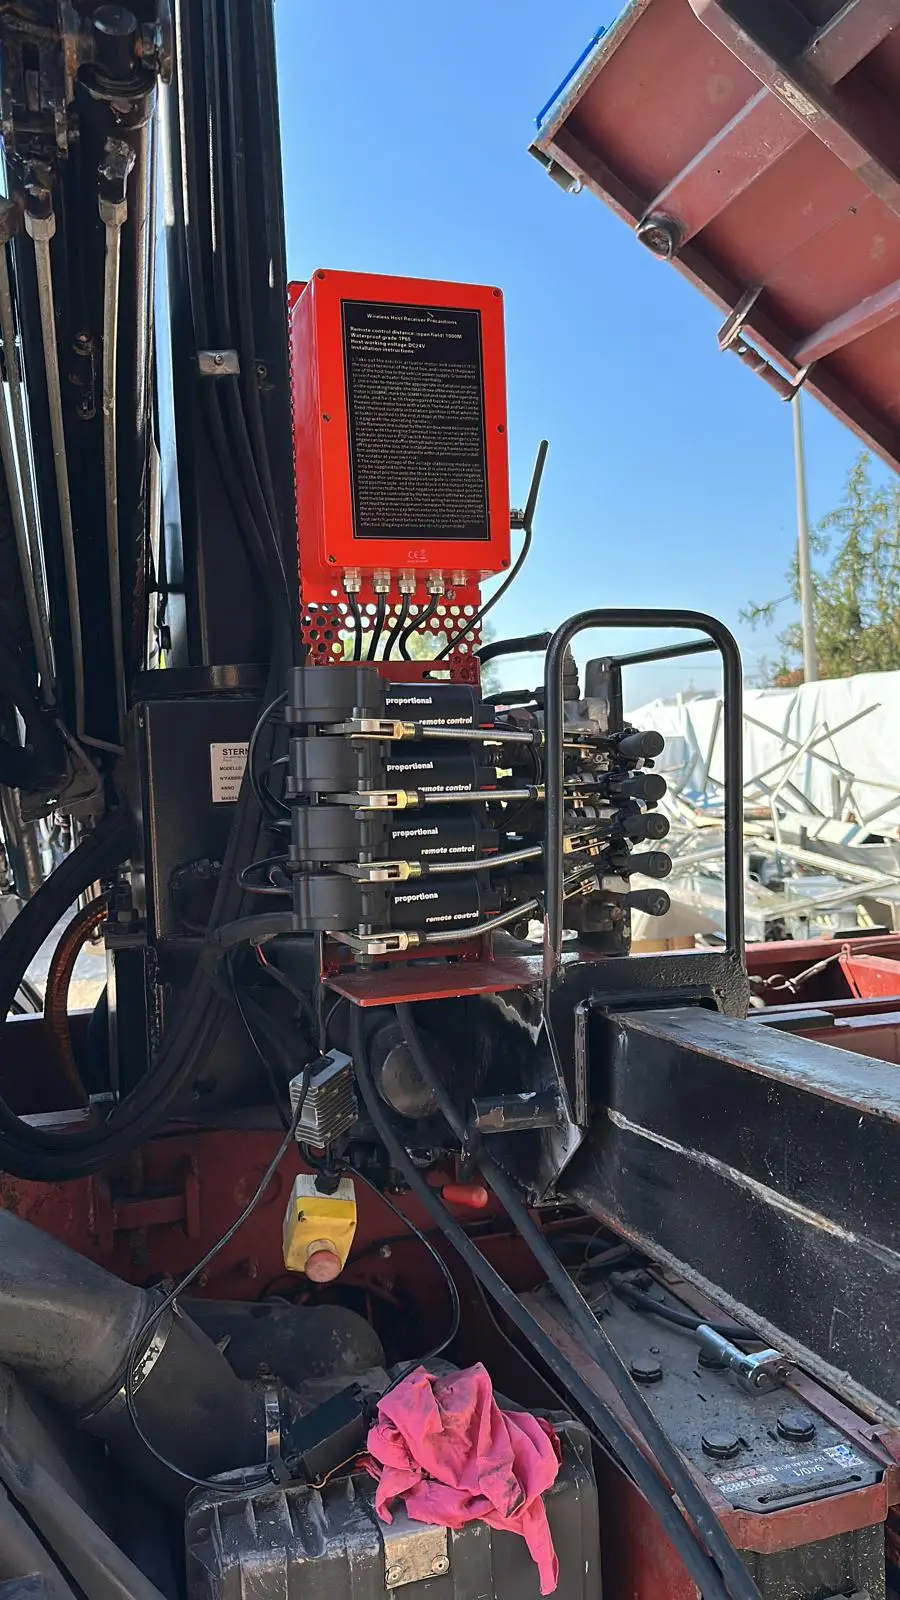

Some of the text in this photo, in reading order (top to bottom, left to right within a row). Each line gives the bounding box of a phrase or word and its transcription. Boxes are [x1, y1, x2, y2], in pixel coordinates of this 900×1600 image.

[386, 697, 432, 705] proportional
[447, 716, 472, 724] control
[387, 762, 433, 772] proportional
[392, 827, 438, 838] proportional
[421, 845, 474, 855] remote control
[426, 911, 478, 923] remote control
[792, 1464, 824, 1476] 940/1
